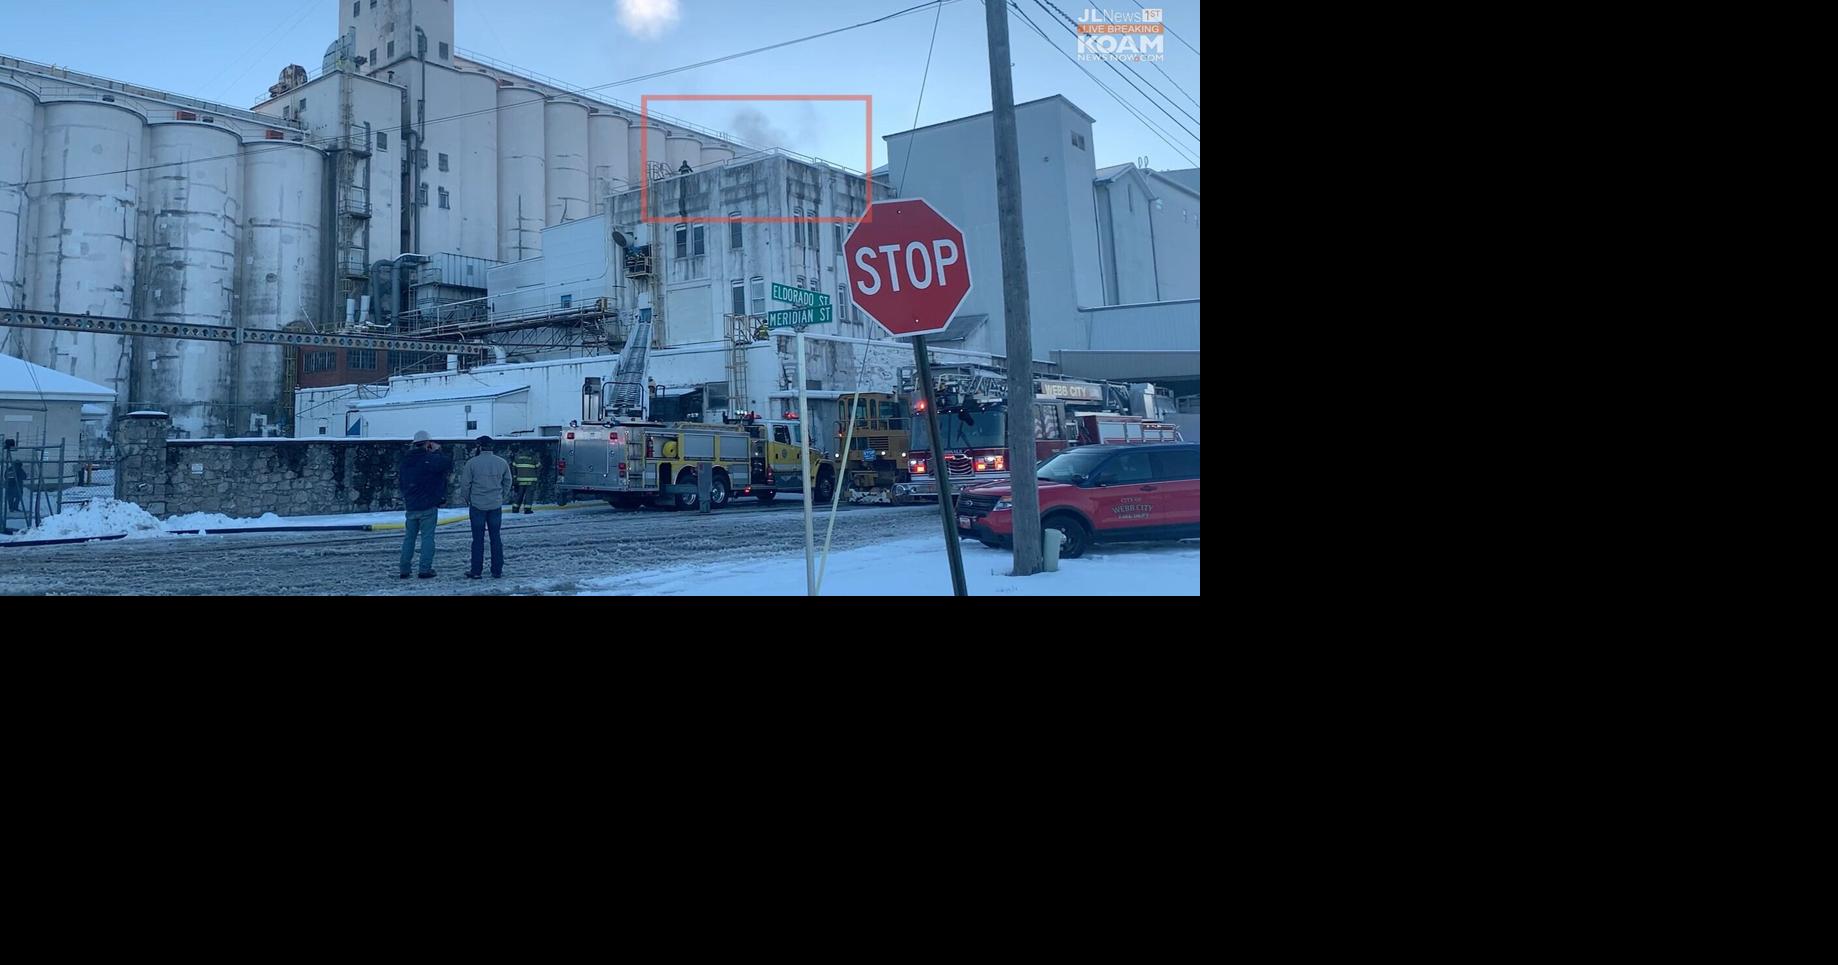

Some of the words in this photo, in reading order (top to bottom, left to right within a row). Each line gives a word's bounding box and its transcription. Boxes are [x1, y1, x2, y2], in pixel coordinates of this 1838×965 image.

[855, 238, 959, 296] STOP
[773, 285, 814, 306] ELDORADO
[769, 309, 814, 326] MERIDIAN
[820, 307, 831, 321] ST
[1045, 383, 1068, 396] WEBB
[1070, 386, 1087, 397] CITY
